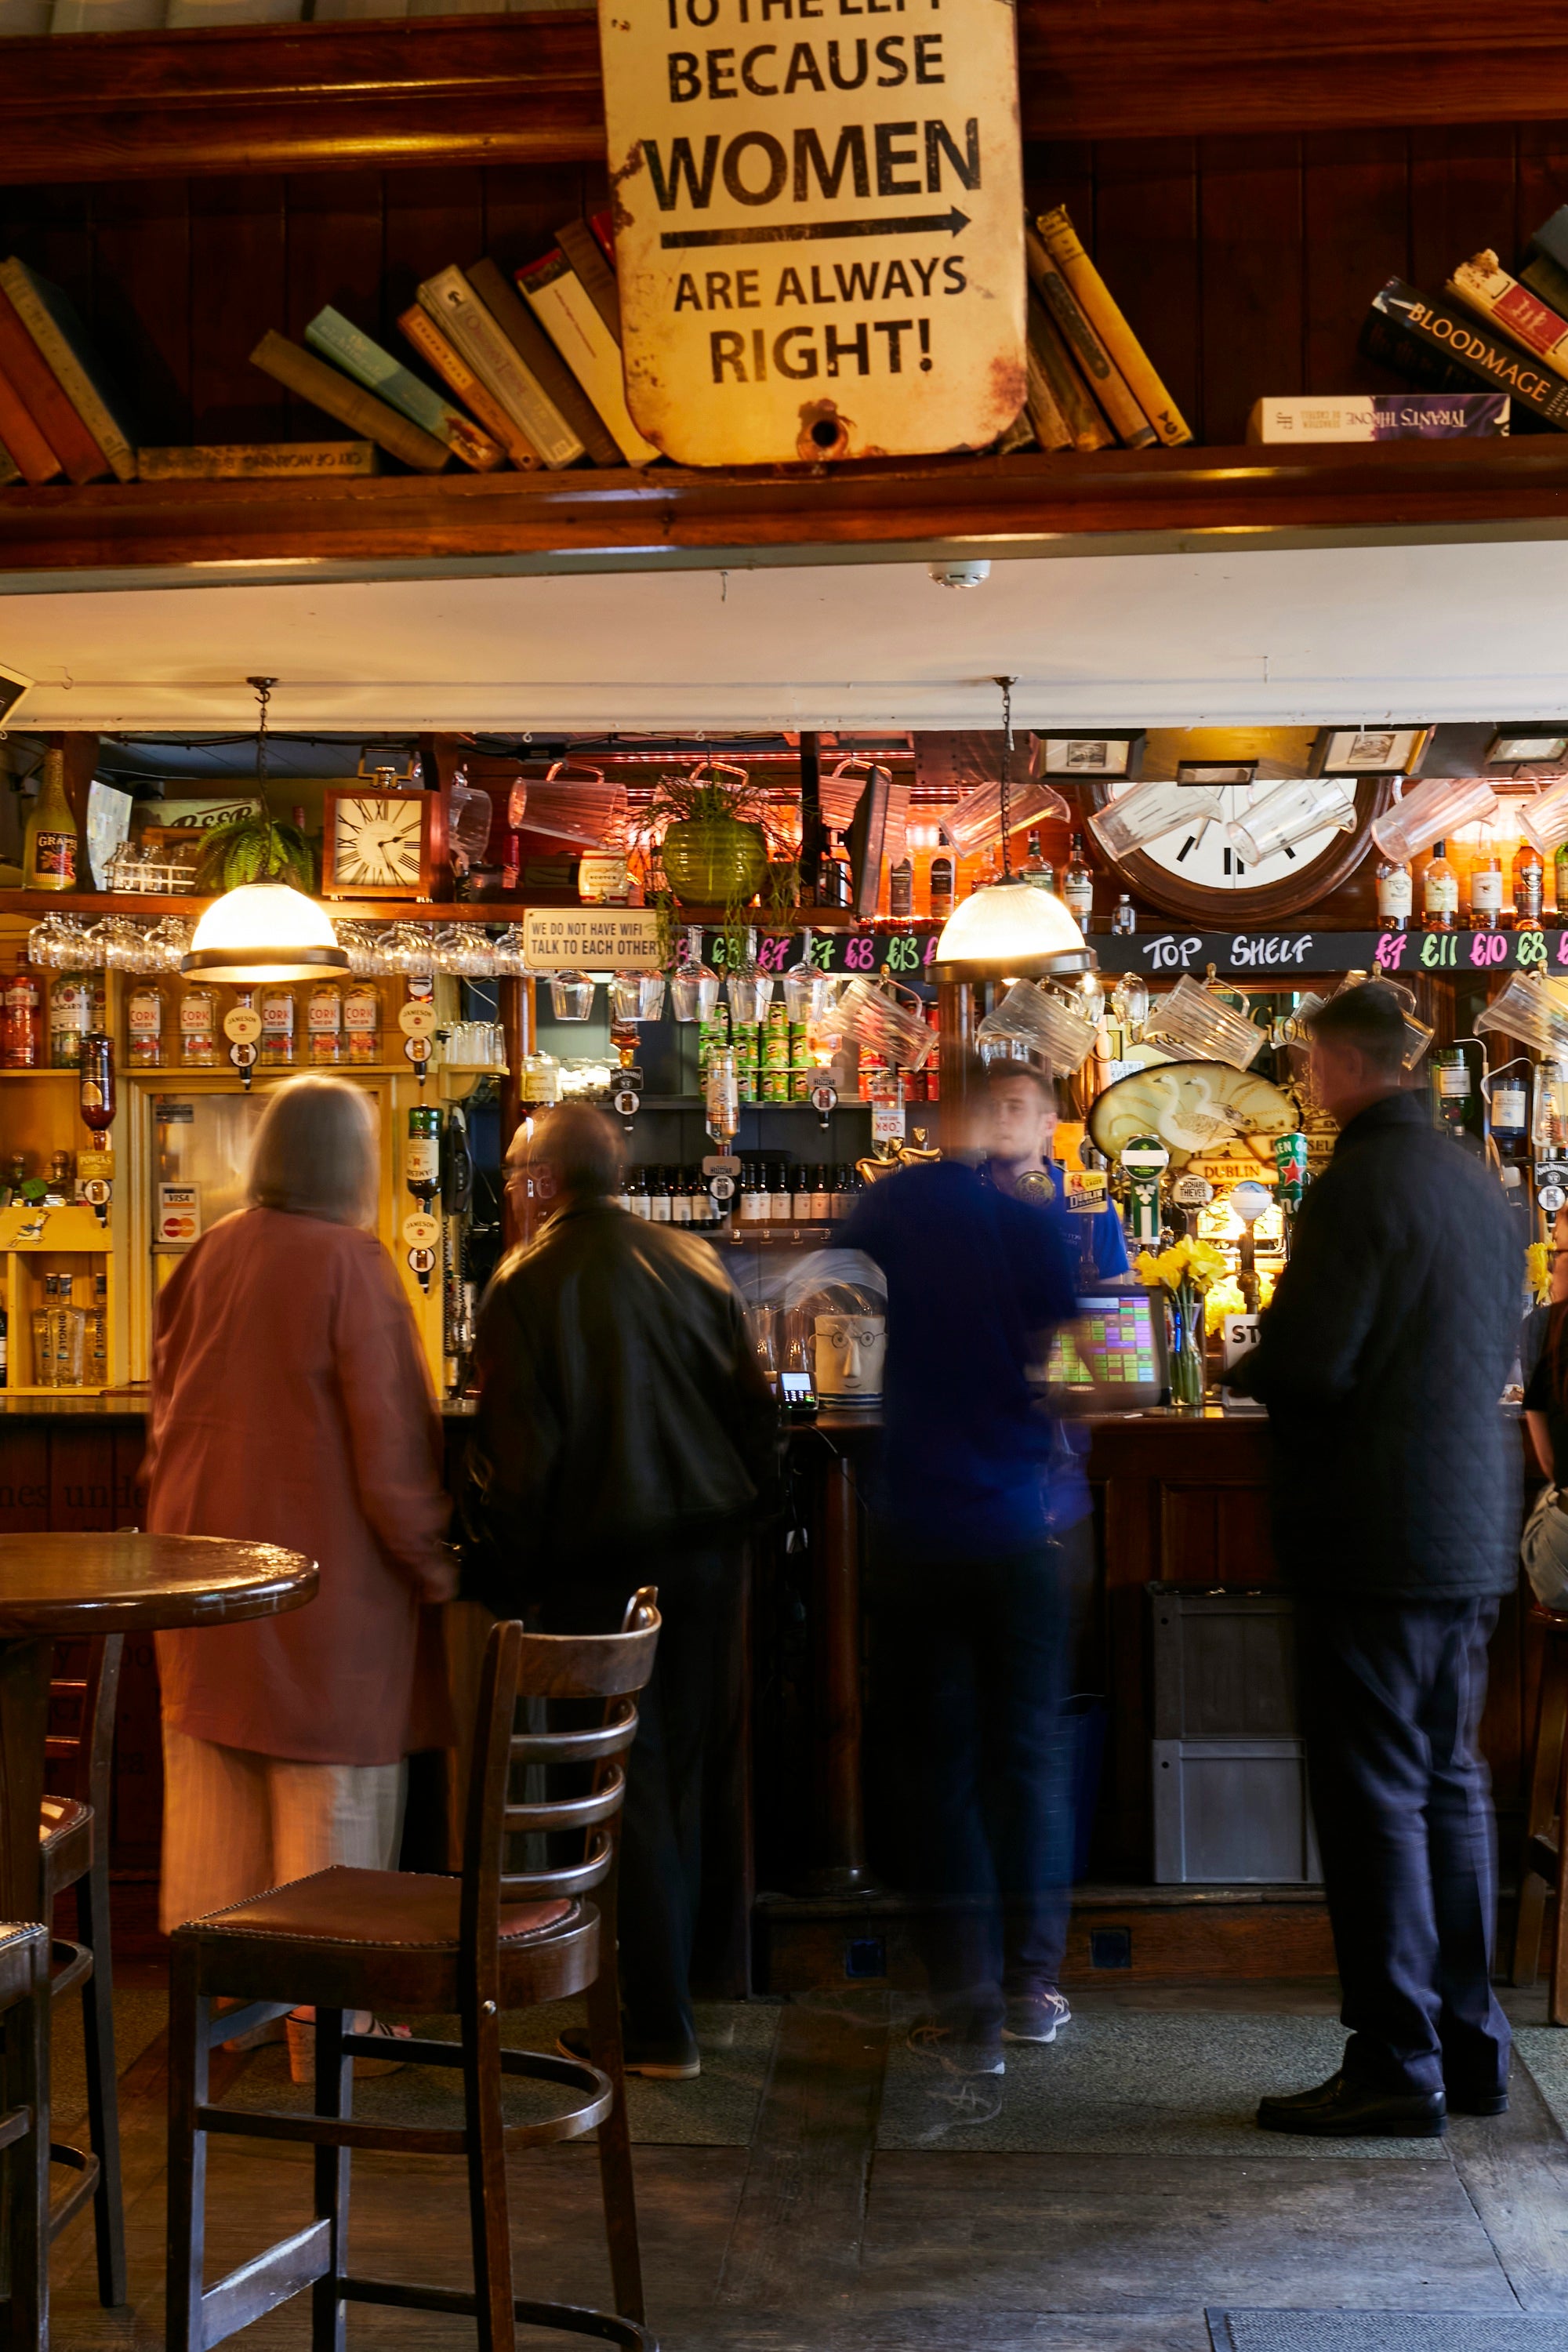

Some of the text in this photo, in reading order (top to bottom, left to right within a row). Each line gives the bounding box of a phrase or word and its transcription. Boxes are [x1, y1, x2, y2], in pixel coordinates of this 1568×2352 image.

[667, 34, 945, 103] BECAUSE
[642, 118, 981, 211] WOMEN
[673, 256, 967, 312] ARE ALWAYS
[710, 318, 931, 383] RIGHT!
[1407, 303, 1551, 402] BLOODMAGE
[1345, 410, 1399, 429] THRONE
[532, 922, 643, 936] WE DO NOT HAVE WIFI
[531, 940, 657, 956] TALK TO EACH OTHER
[1142, 934, 1313, 970] TOP SHELF
[1420, 933, 1458, 967] €11
[1469, 932, 1508, 967] €10
[131, 1010, 157, 1022] CORK
[181, 1010, 209, 1022] CORK
[227, 1015, 257, 1025] JAMESON
[263, 1008, 290, 1020] CORK
[310, 1008, 337, 1020] CORK
[346, 1007, 374, 1019] CORK
[874, 1121, 902, 1133] CORK
[1204, 1165, 1261, 1178] DUBLIN
[169, 1194, 191, 1203] VISA
[1180, 1188, 1206, 1197] THIEVES
[58, 1315, 67, 1350] DINGLE
[95, 1314, 104, 1348] DINGLE
